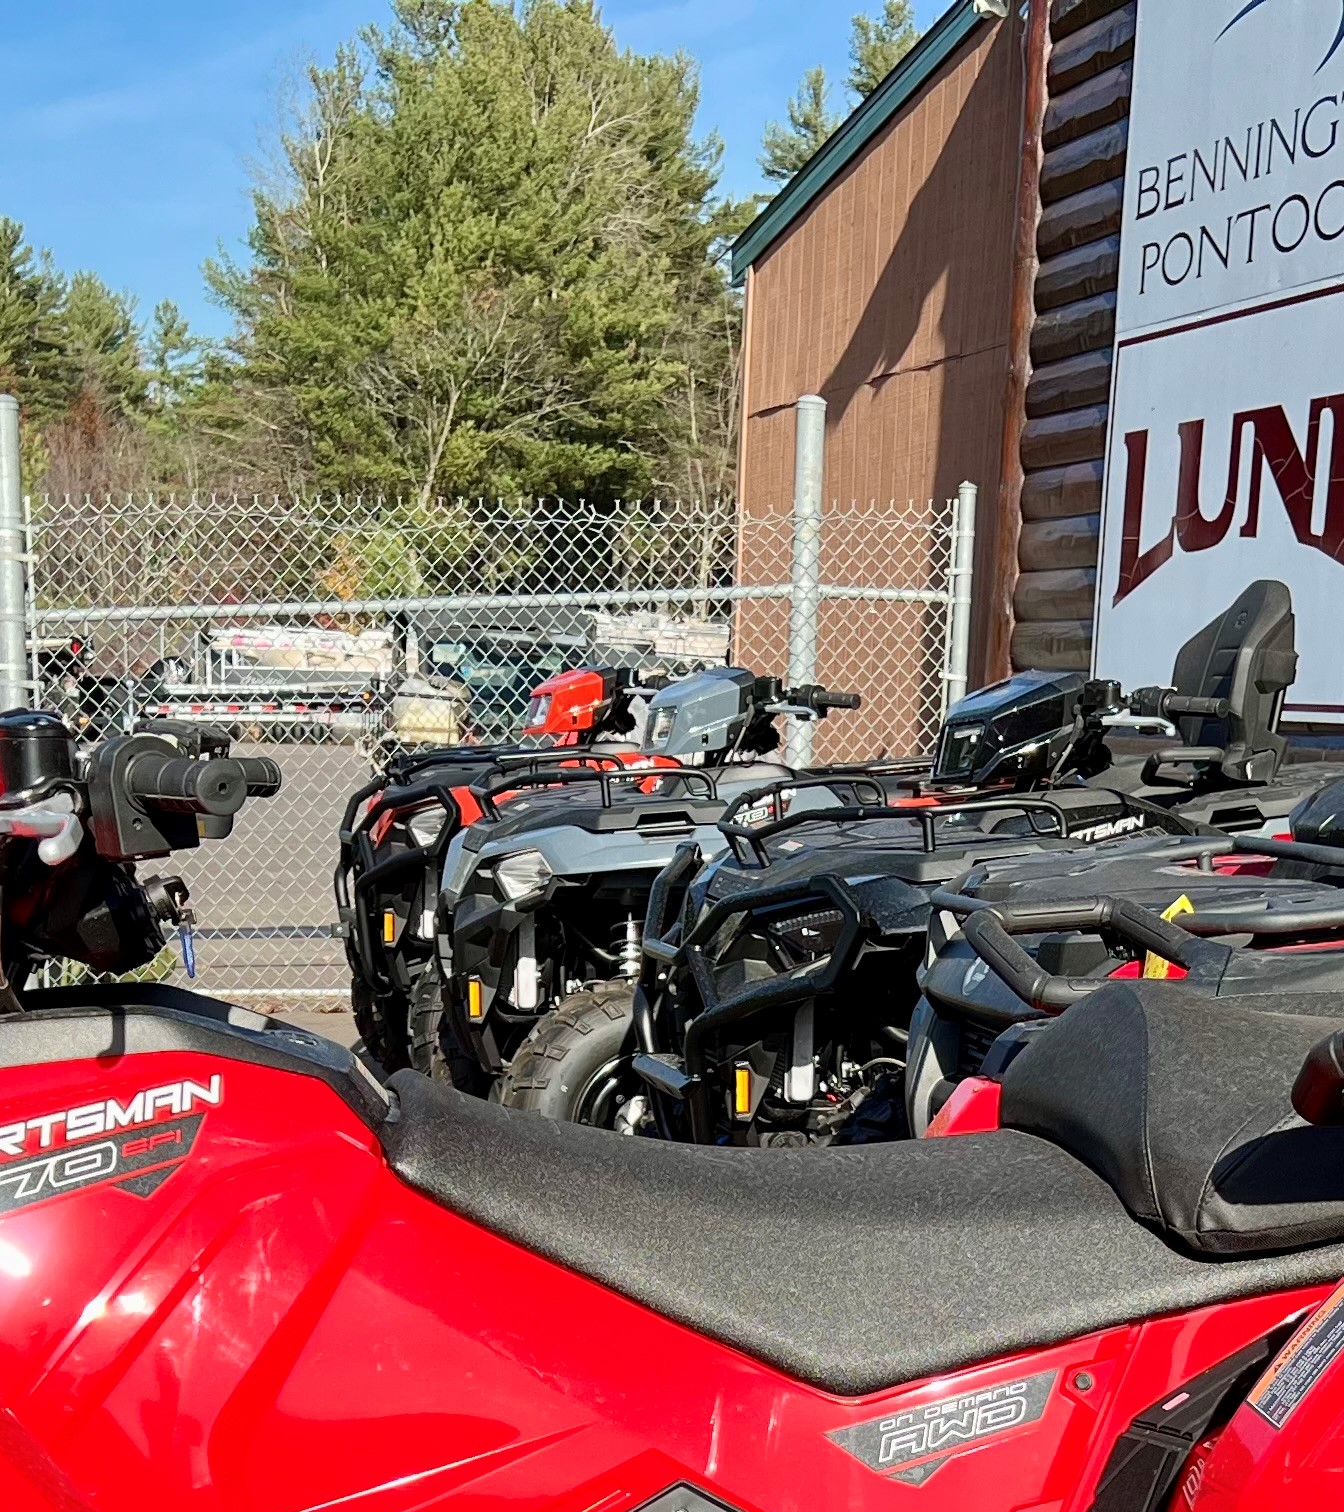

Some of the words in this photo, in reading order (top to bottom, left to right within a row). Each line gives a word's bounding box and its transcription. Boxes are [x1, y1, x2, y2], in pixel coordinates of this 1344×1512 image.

[121, 1129, 183, 1157] EFI
[1283, 1309, 1328, 1360] WARNING
[878, 1395, 1028, 1463] AWD
[879, 1413, 914, 1432] ON
[923, 1382, 1028, 1420] DEMAND
